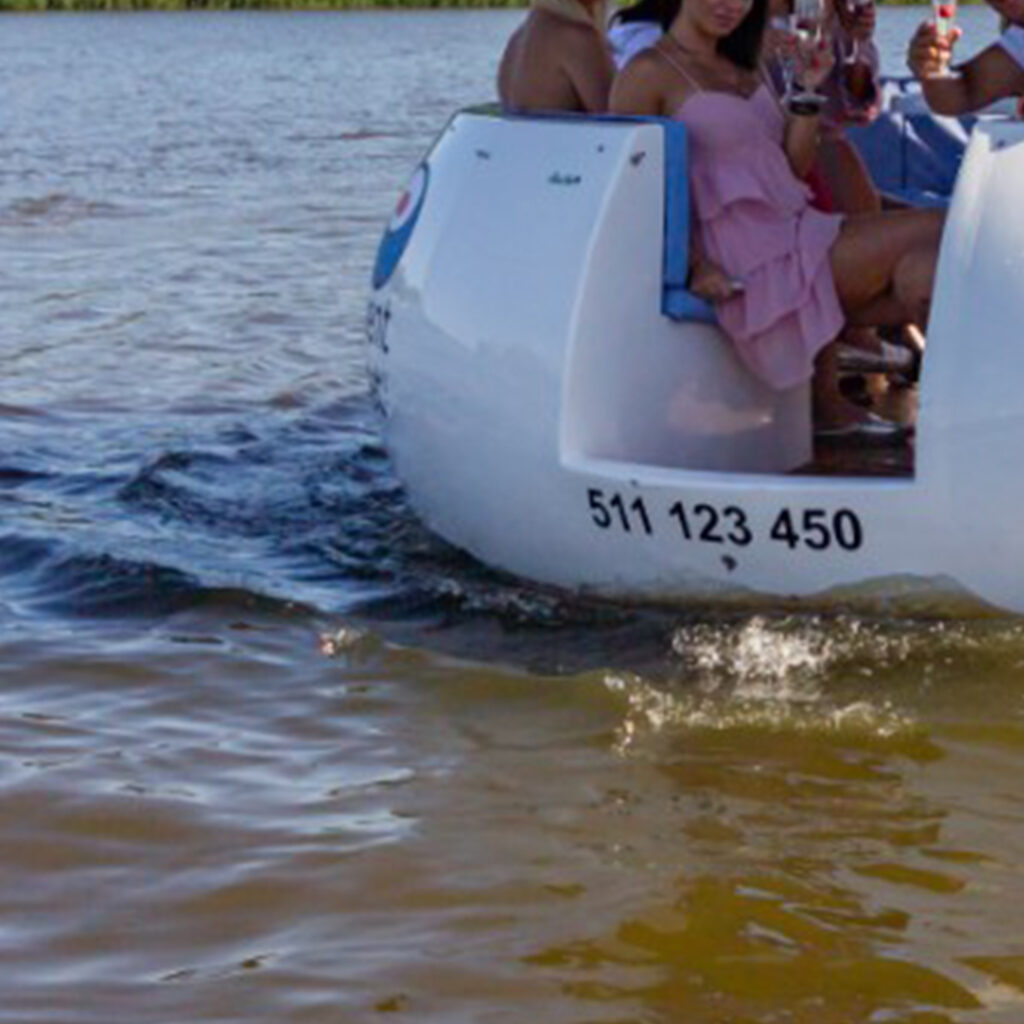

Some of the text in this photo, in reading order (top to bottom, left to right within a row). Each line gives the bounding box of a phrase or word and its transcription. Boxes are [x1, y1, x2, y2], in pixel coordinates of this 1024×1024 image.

[587, 488, 864, 552] 511 123 450
